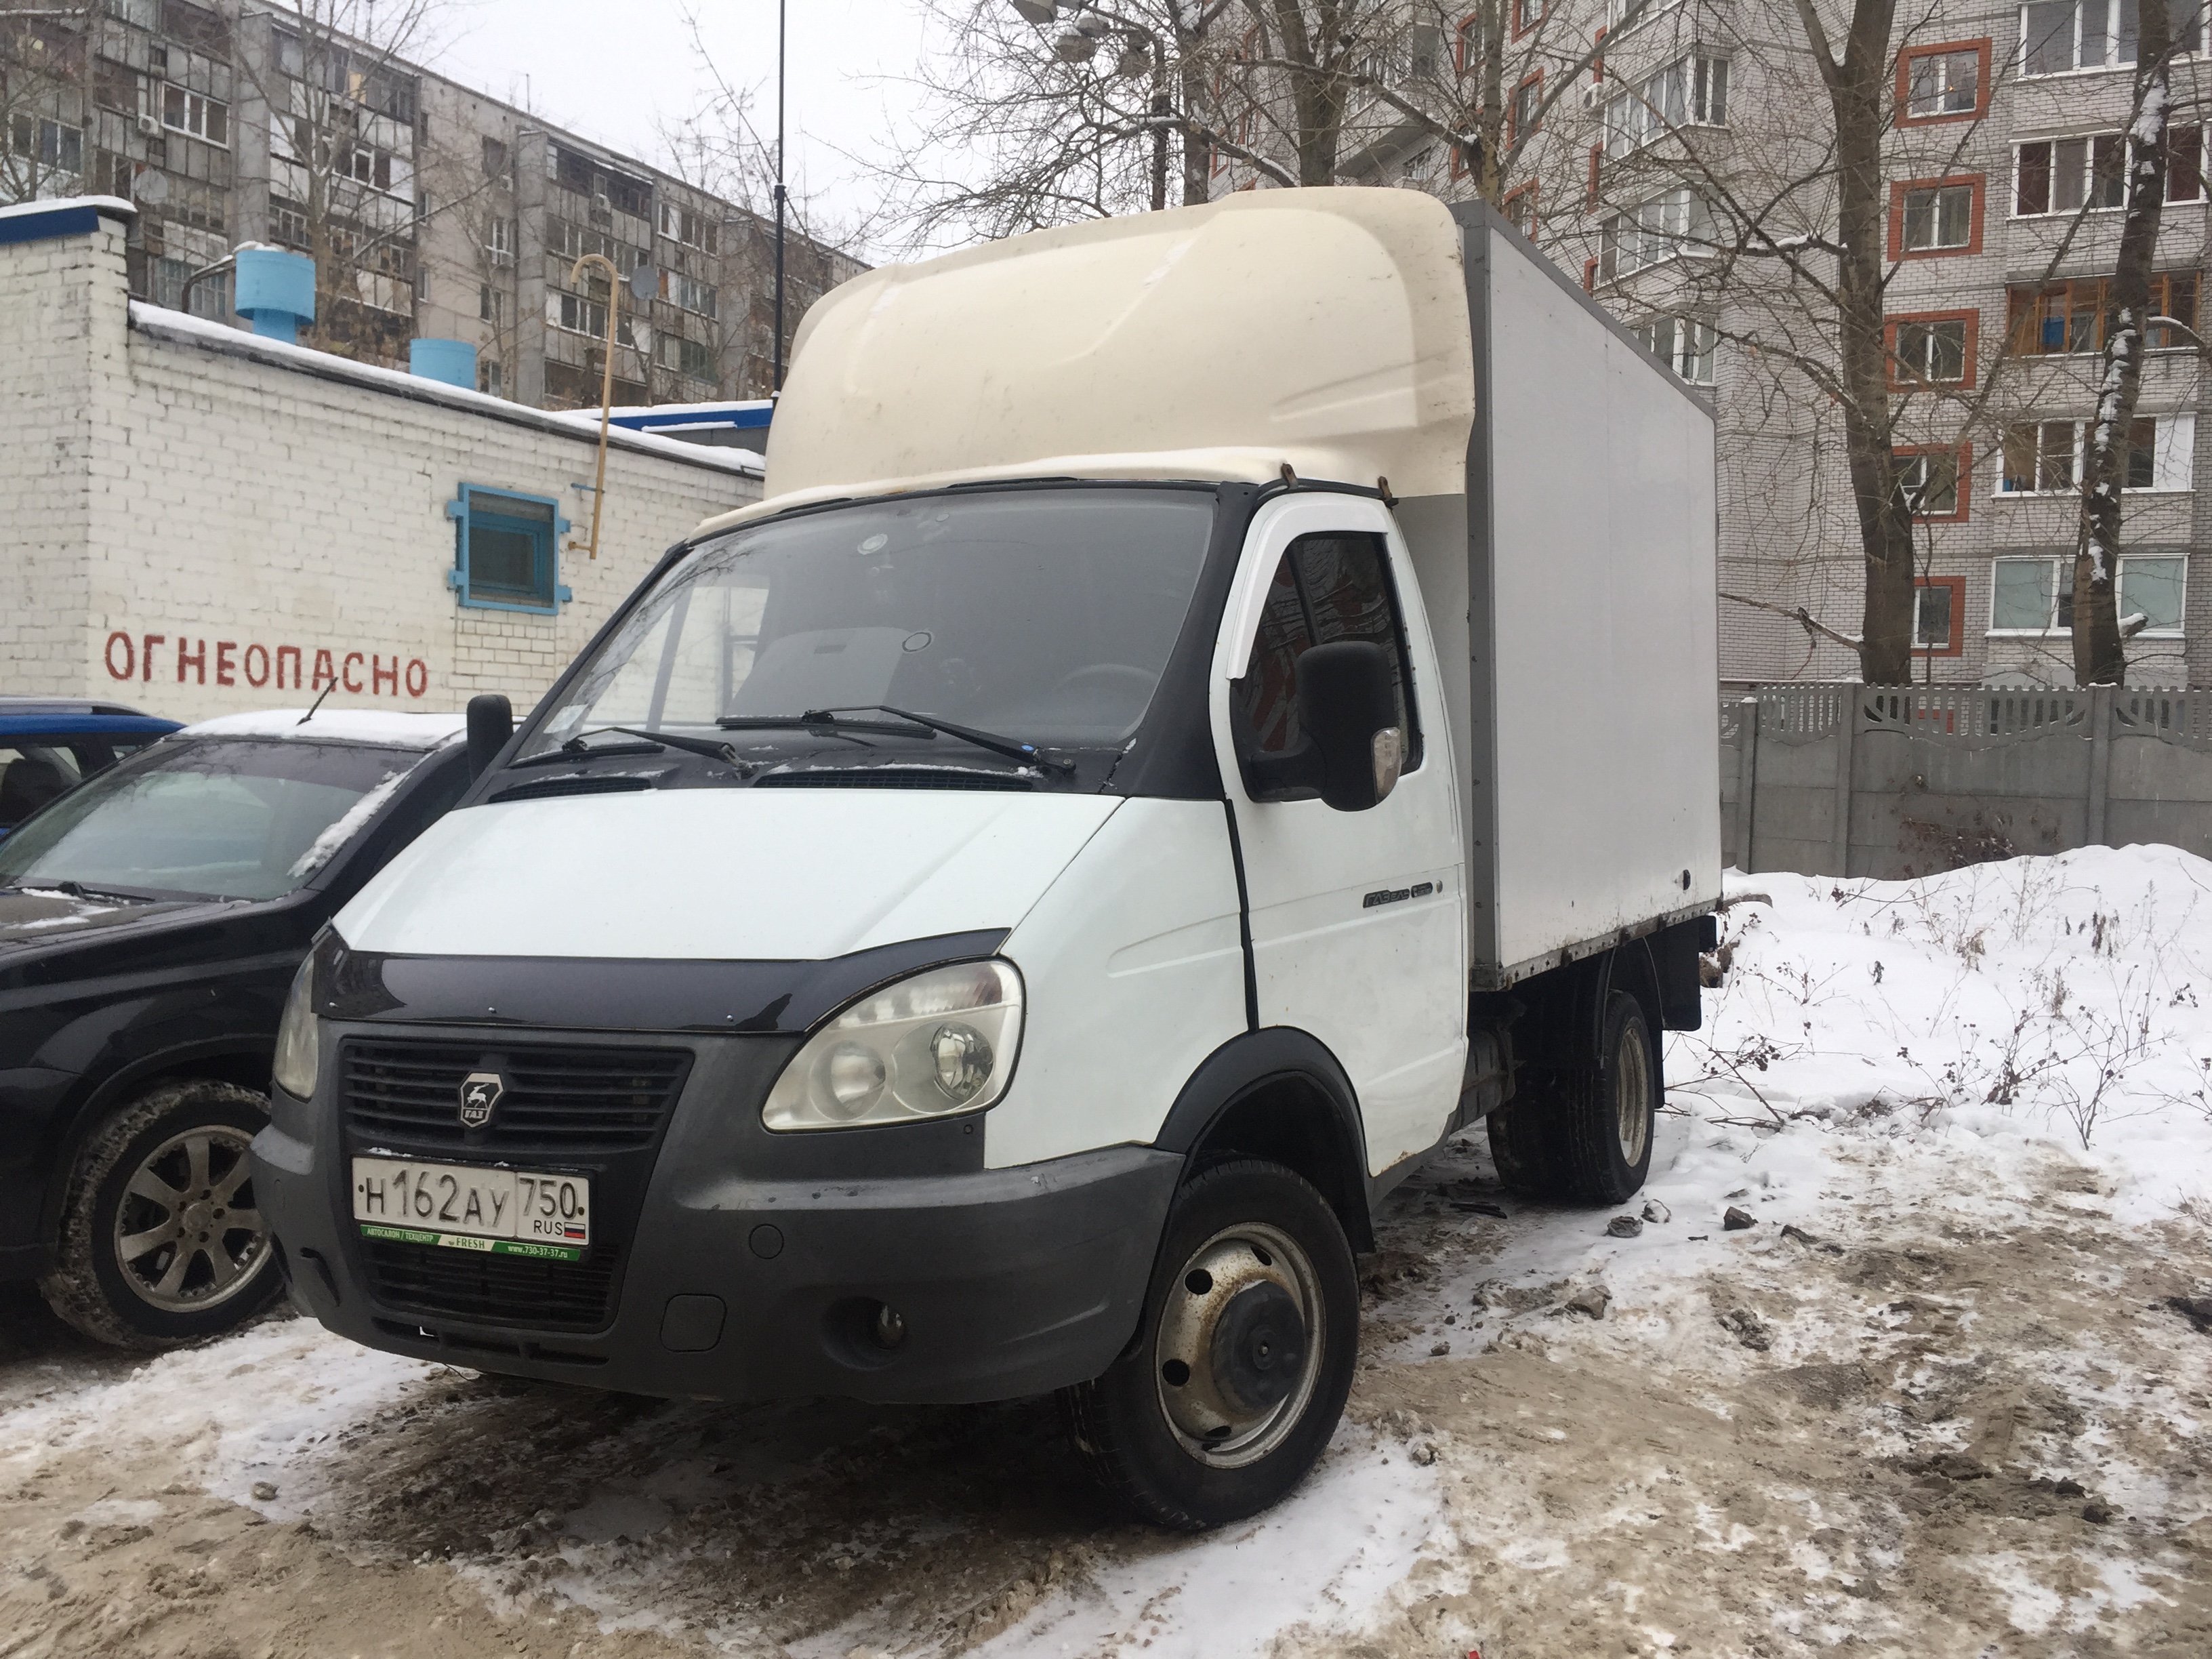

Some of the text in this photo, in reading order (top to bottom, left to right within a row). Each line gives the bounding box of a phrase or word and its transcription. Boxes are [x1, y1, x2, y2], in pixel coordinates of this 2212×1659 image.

[105, 631, 428, 697] ОГНЕОПАСНО
[464, 1109, 484, 1119] ГАЗ
[519, 1177, 579, 1221] 750
[367, 1227, 400, 1240] АВТОСАЛОН
[405, 1231, 434, 1242] ТЕХЦЕНТР
[533, 1221, 563, 1236] RUS
[456, 1237, 485, 1249] FRESH
[508, 1245, 568, 1258] www.730-37-37.ru
